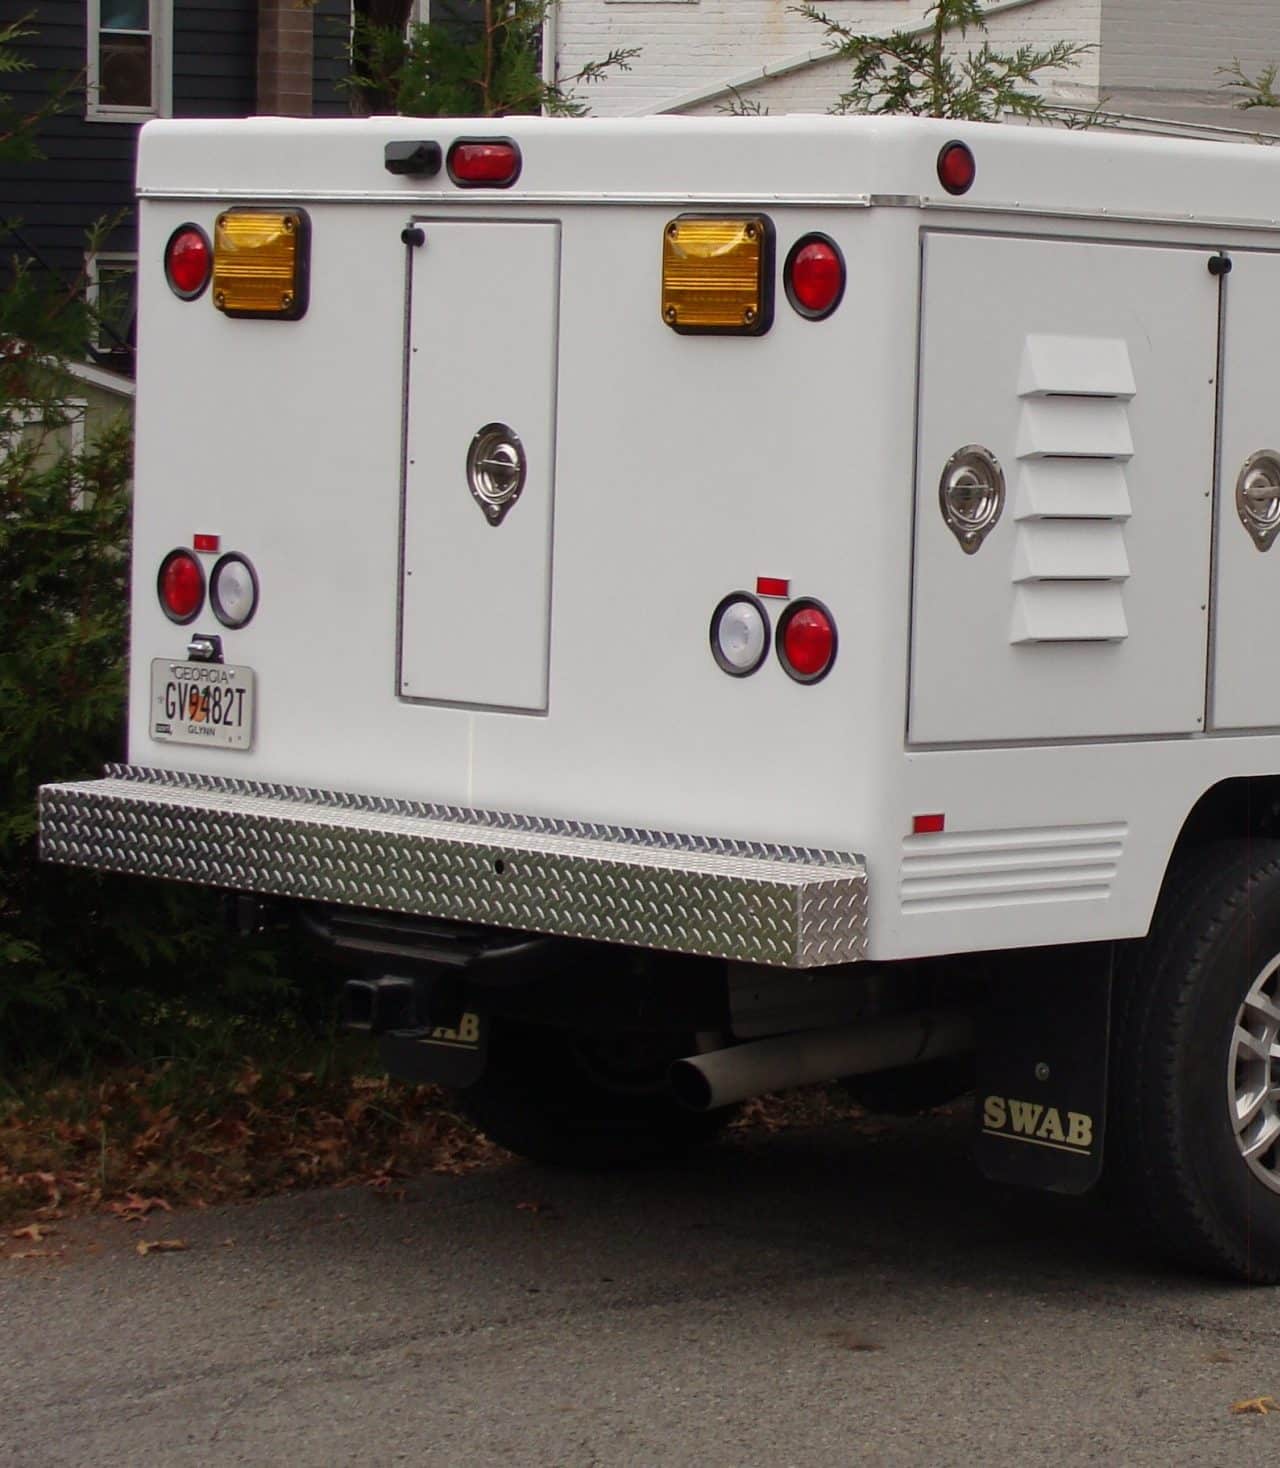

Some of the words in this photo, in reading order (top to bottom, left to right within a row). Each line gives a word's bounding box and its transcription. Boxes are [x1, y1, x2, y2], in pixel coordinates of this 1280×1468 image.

[174, 665, 229, 683] GEORGIA
[165, 682, 246, 728] GV9482T
[187, 724, 216, 736] GLYNN
[983, 1095, 1093, 1147] SWAB
